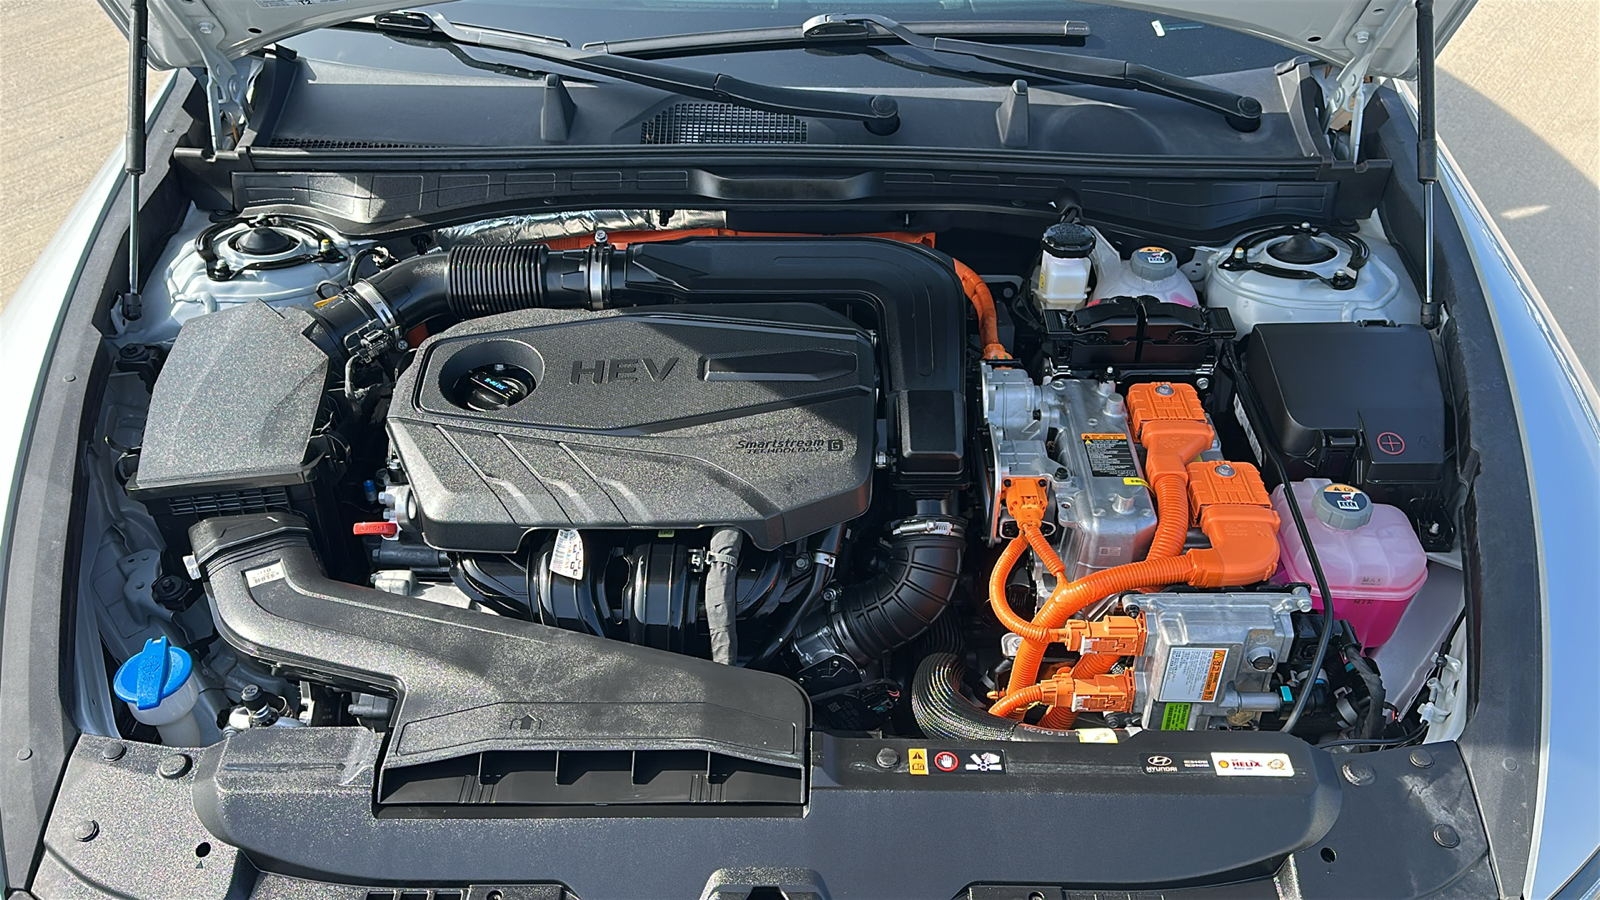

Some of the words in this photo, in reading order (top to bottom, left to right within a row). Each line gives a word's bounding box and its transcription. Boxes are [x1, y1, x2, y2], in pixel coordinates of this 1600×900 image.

[569, 357, 680, 384] HEV
[736, 438, 825, 450] Smartstream
[1231, 760, 1261, 768] HELIX
